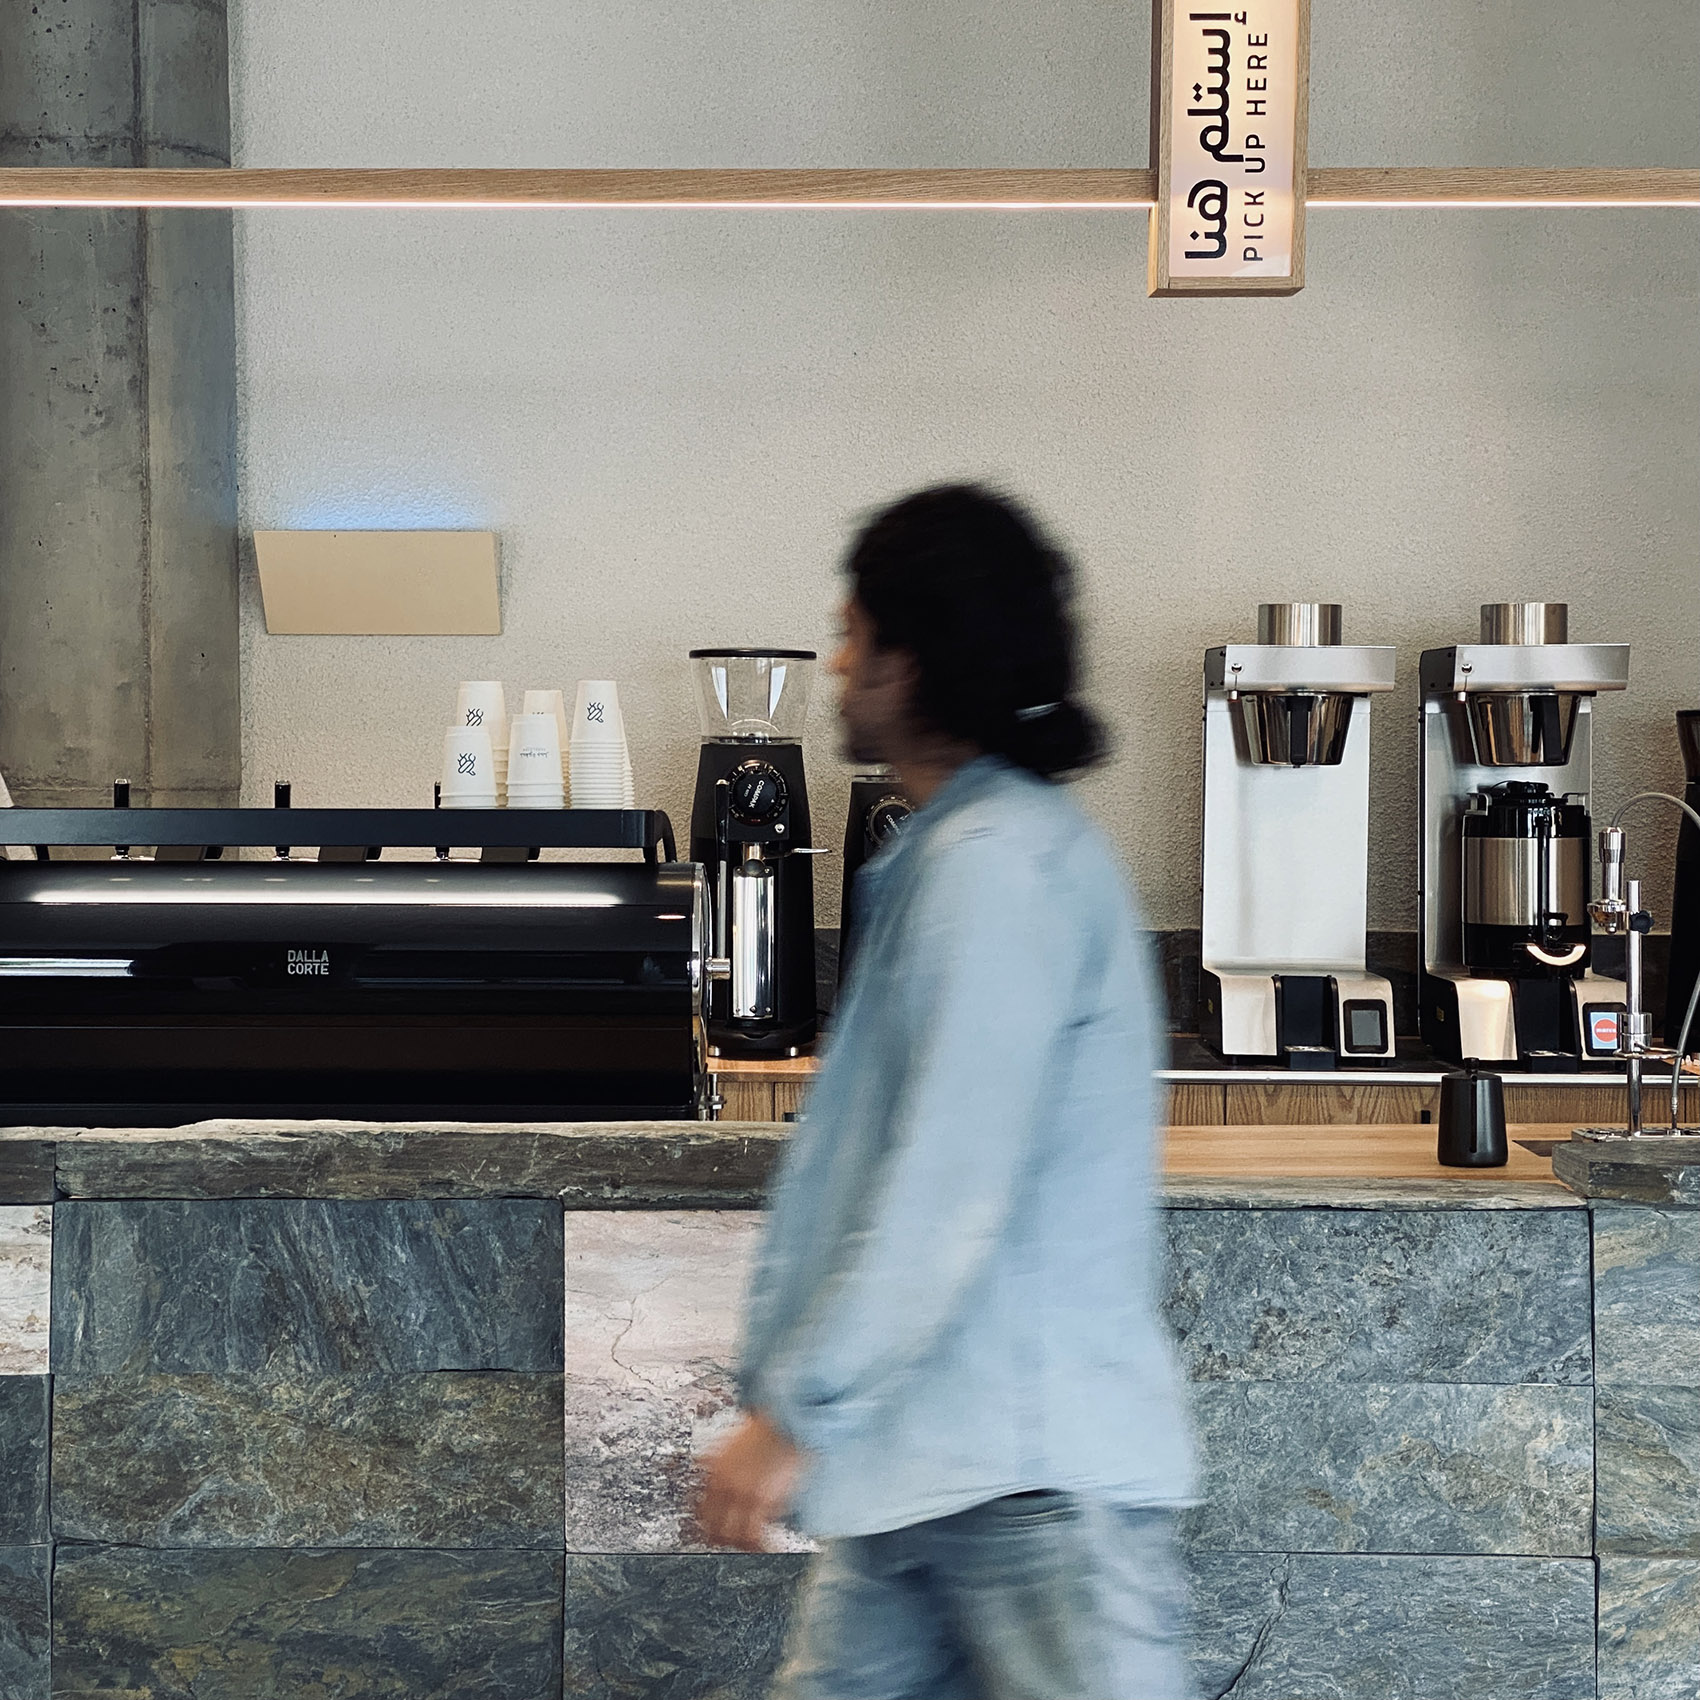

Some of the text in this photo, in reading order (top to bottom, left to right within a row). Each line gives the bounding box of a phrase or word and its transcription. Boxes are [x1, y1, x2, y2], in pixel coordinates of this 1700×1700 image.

[1184, 11, 1247, 259] إستلم هنا
[1243, 33, 1268, 261] PICK UP HERE
[748, 780, 765, 808] COMPAK
[287, 949, 329, 962] DALLA
[287, 963, 330, 975] CORTE
